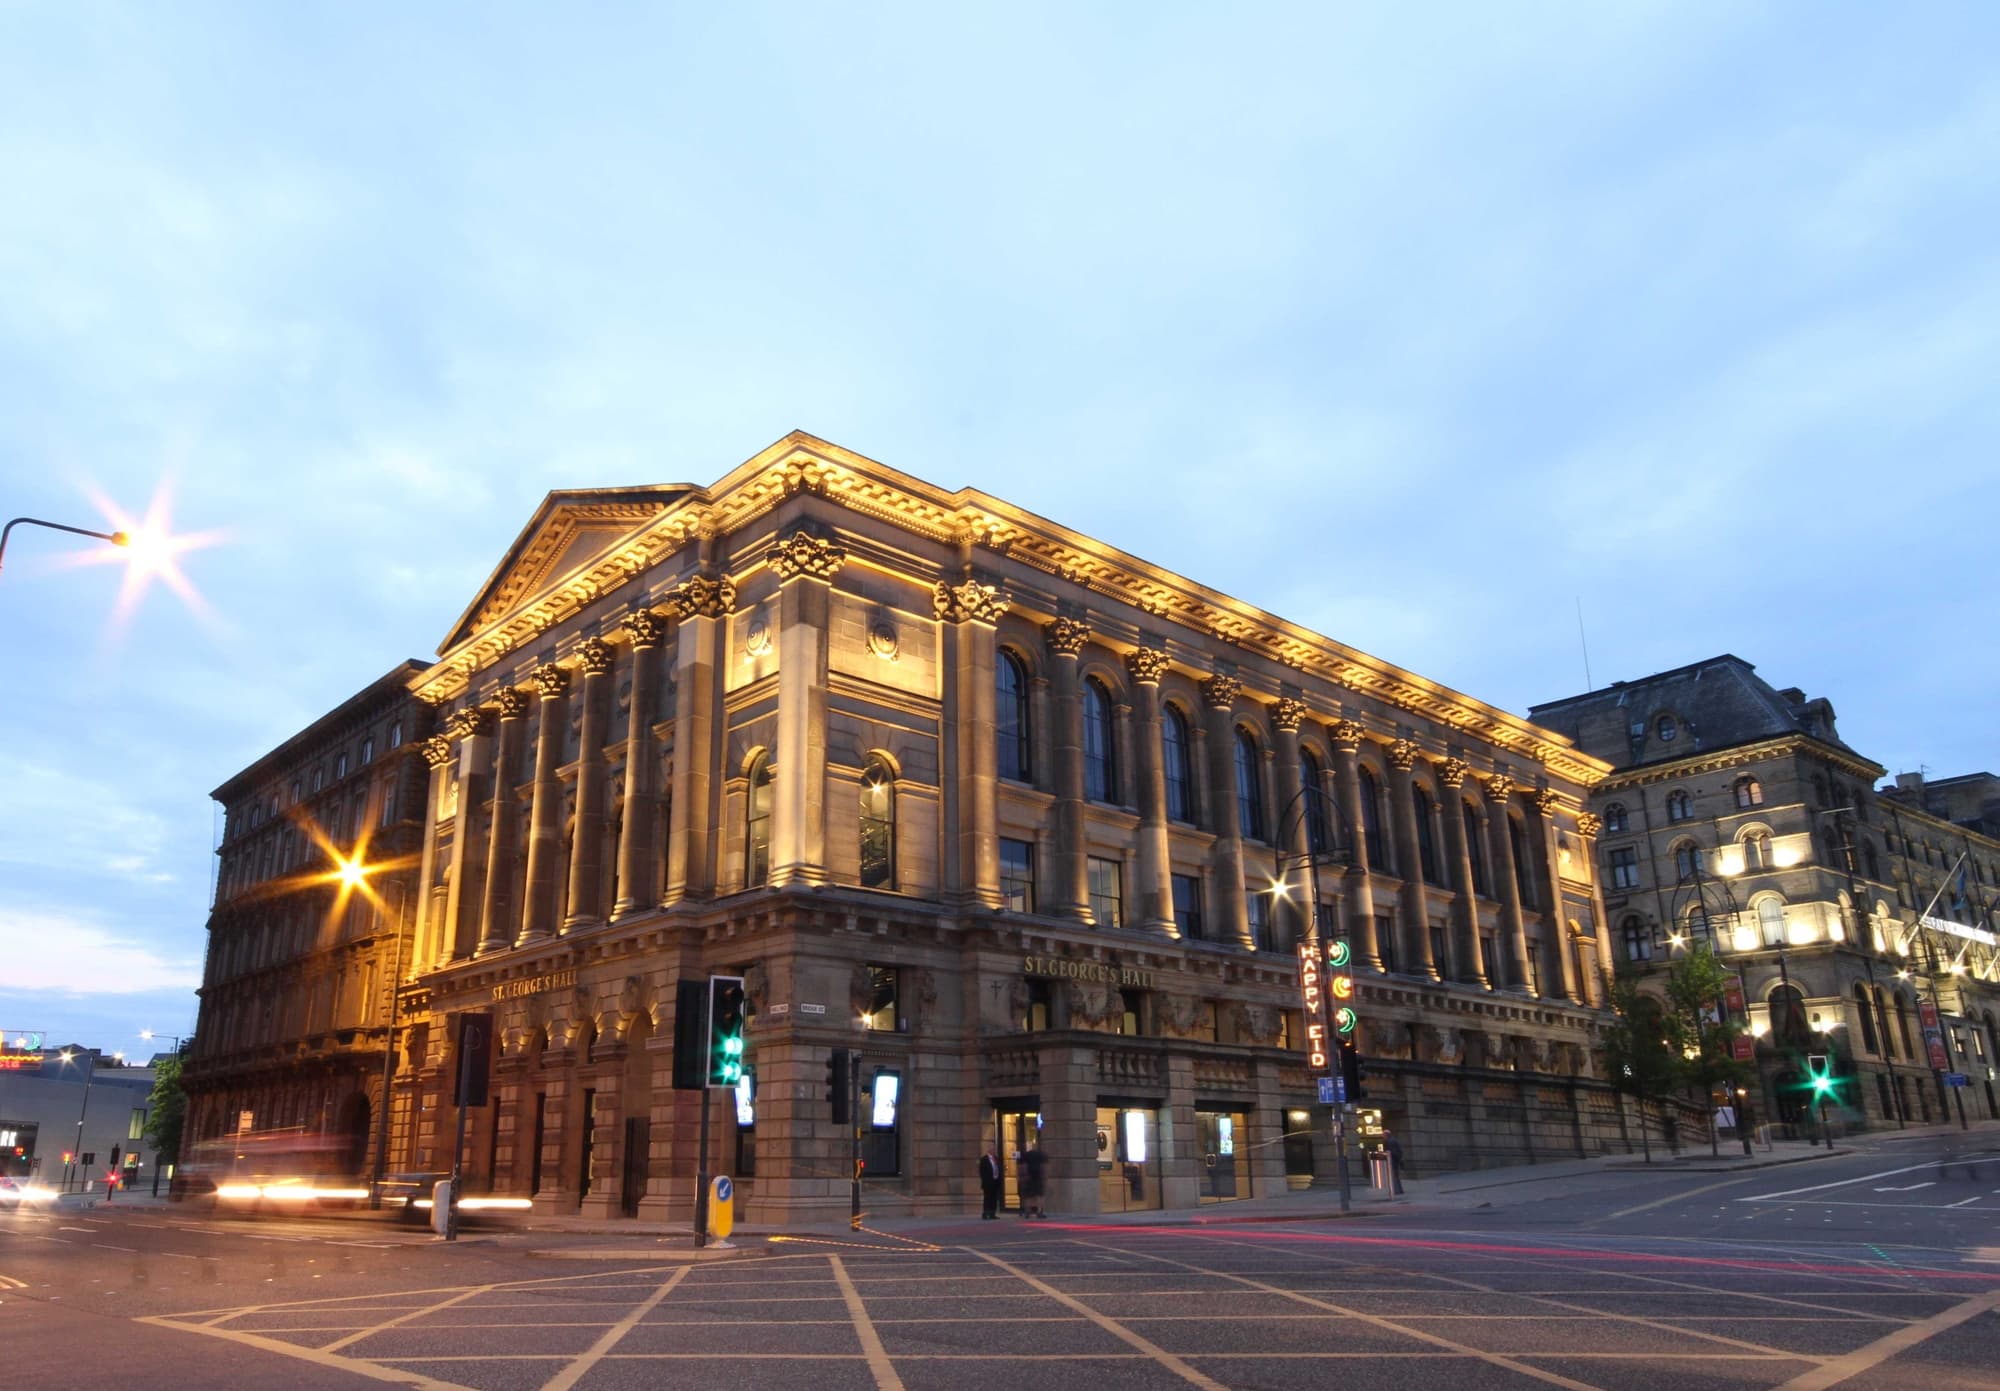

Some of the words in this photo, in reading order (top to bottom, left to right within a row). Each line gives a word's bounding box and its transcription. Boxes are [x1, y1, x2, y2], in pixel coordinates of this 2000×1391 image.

[506, 976, 551, 998] GEORGE'S
[552, 971, 577, 989] HALL
[1024, 956, 1047, 974] ST.
[1048, 960, 1117, 983] GEORGE'S
[1122, 967, 1156, 987] HALL
[1301, 947, 1318, 1014] HAPPY
[1309, 1026, 1325, 1066] EID
